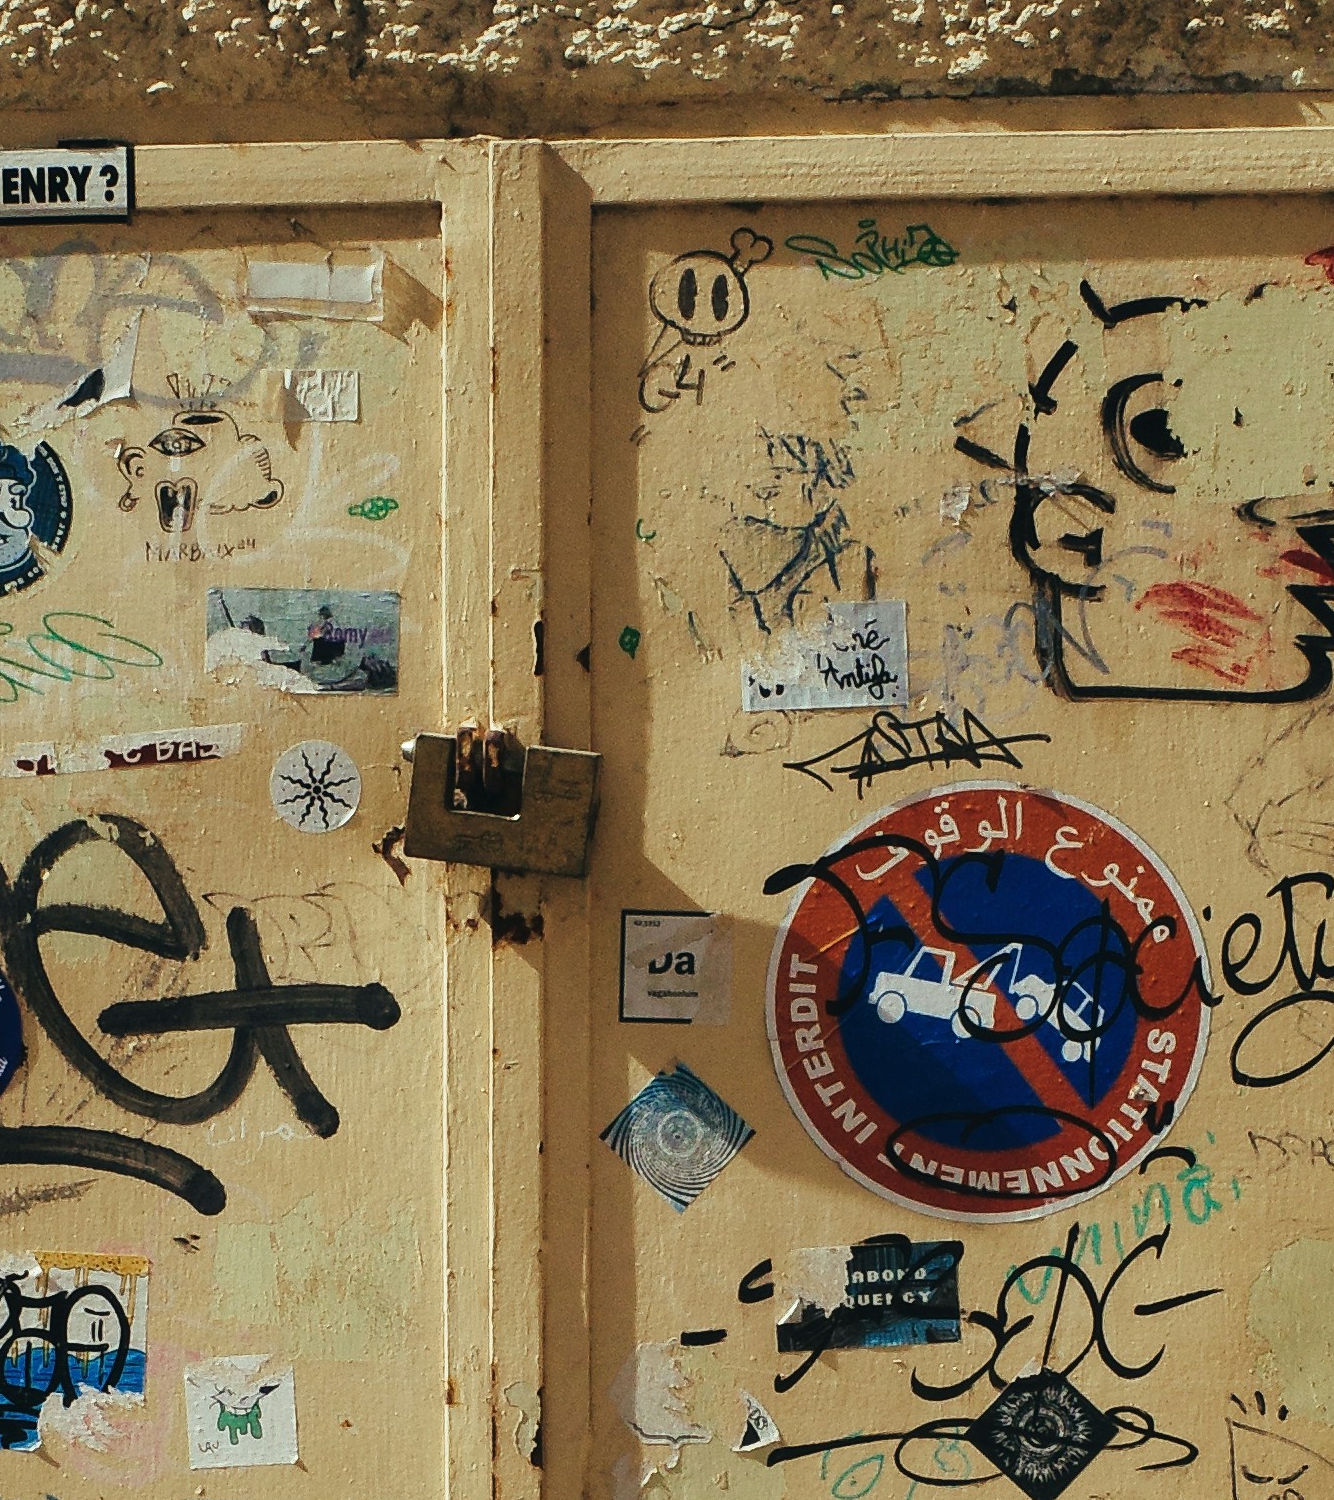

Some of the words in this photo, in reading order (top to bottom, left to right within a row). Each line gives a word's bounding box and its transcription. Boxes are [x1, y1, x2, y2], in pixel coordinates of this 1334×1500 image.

[99, 164, 119, 202] ?
[1044, 825, 1171, 943] ممنوع
[789, 953, 878, 1146] INTERDIT
[878, 1027, 1177, 1195] STATIONNEMENT
